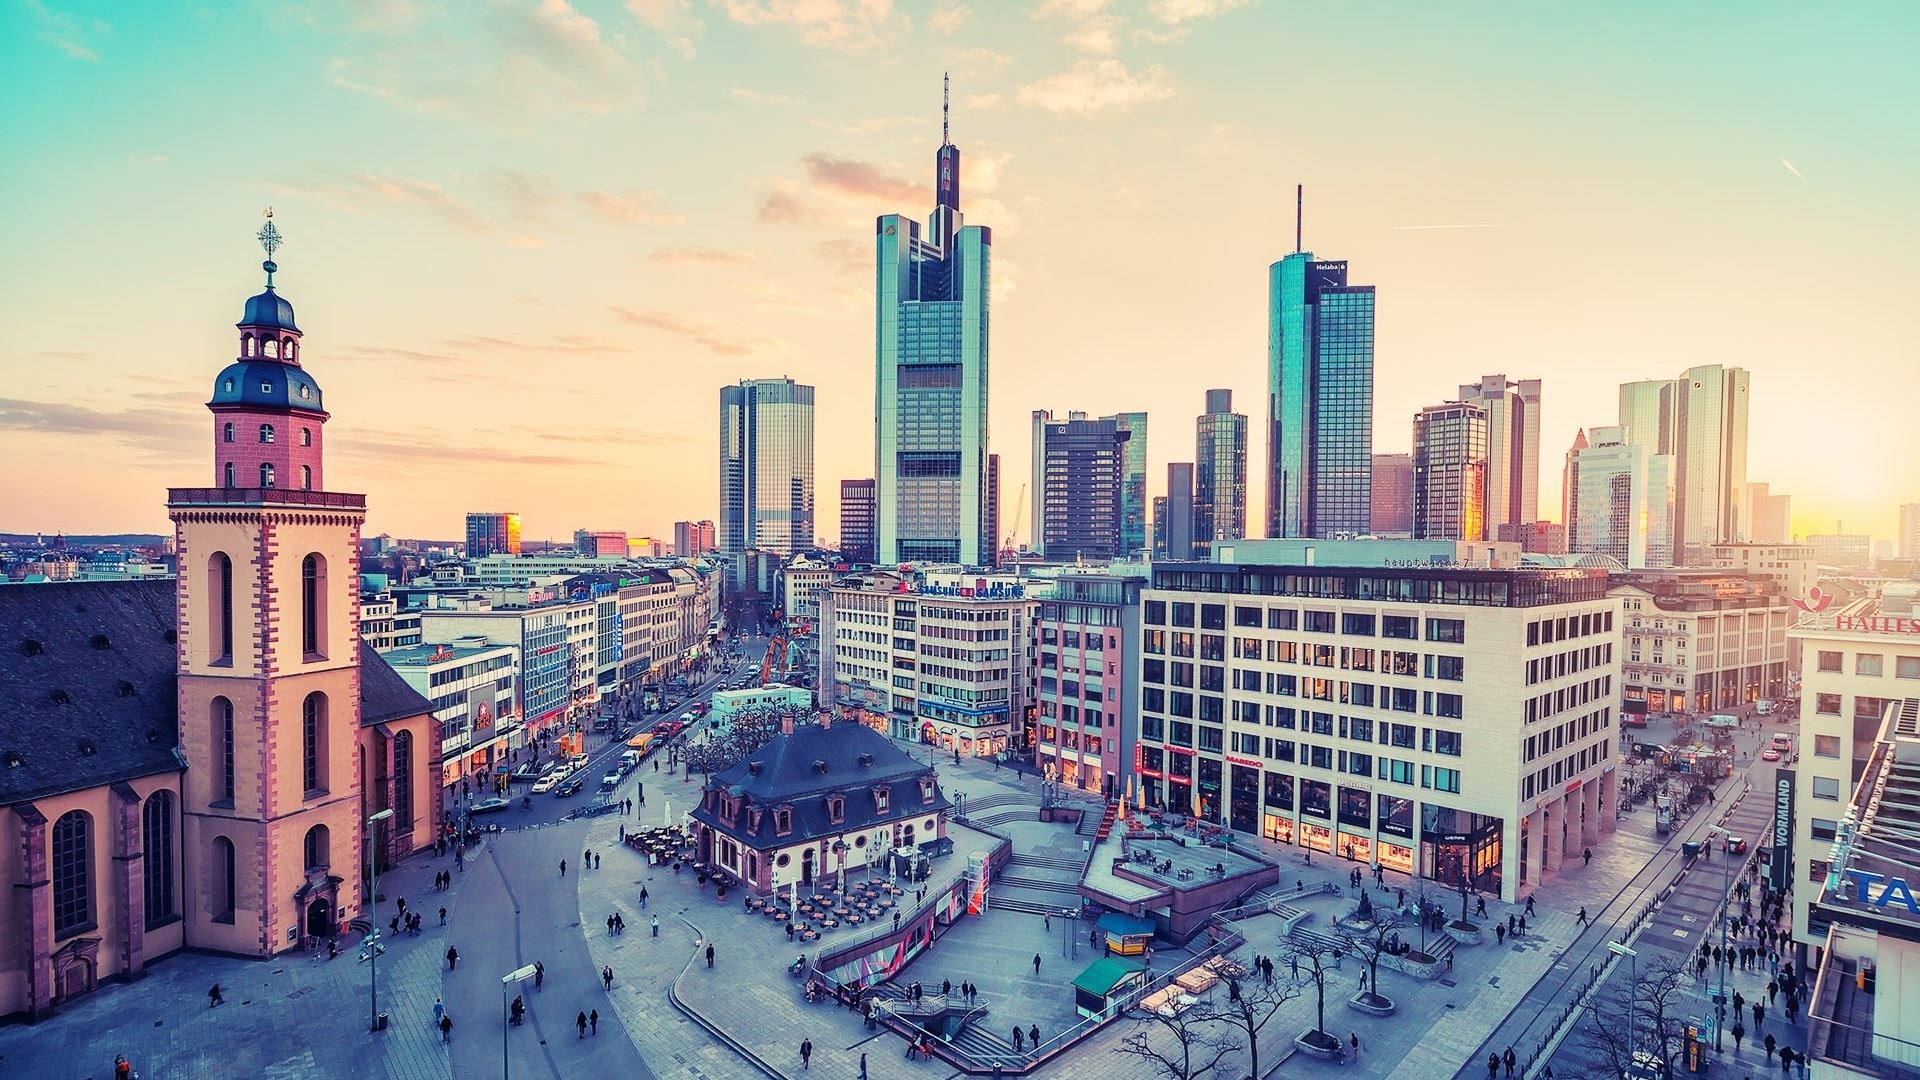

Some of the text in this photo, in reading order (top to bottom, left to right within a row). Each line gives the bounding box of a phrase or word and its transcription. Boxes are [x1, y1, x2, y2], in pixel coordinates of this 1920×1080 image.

[919, 585, 960, 597] SAMSUNG
[975, 585, 1024, 598] SAMSUNG
[1836, 614, 1920, 634] HALLES
[1164, 744, 1197, 756] MAREDO
[1226, 755, 1263, 768] MAREDO
[1776, 779, 1790, 847] WORMLAND
